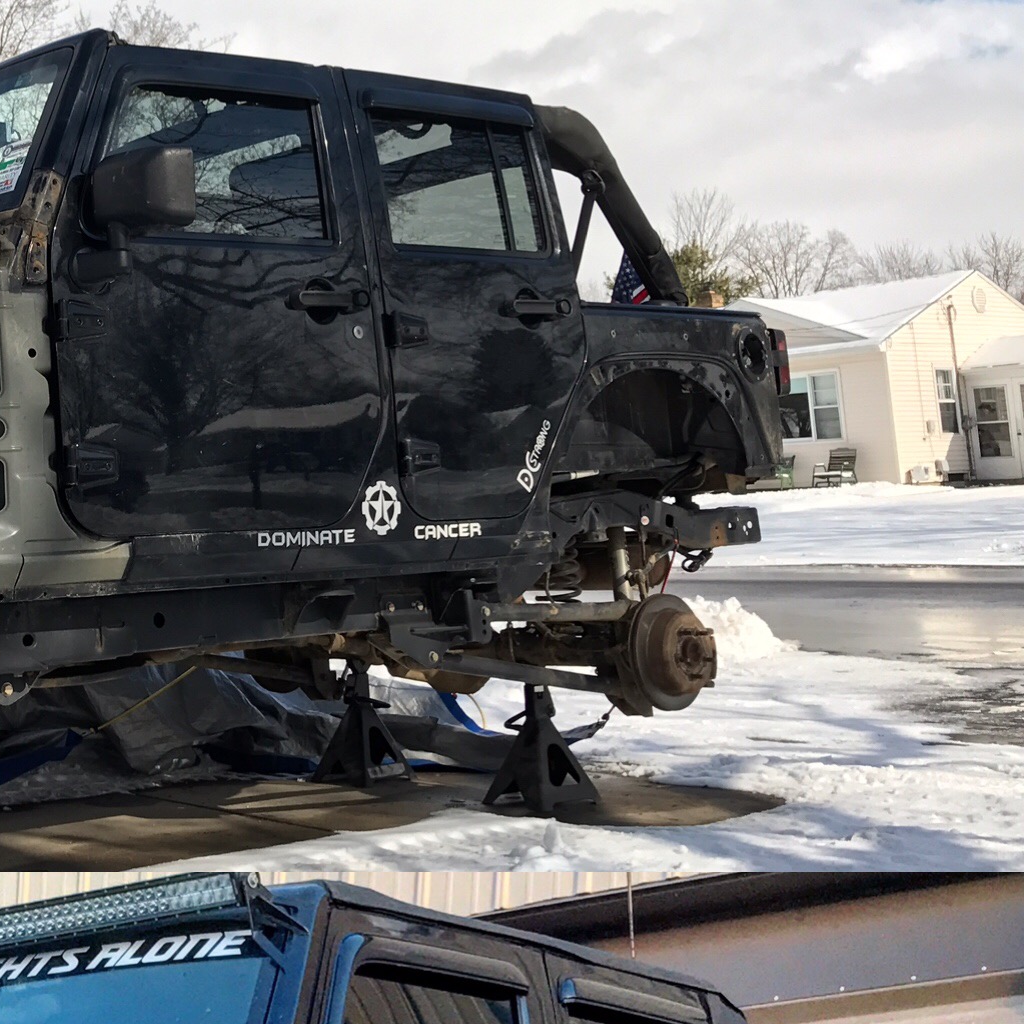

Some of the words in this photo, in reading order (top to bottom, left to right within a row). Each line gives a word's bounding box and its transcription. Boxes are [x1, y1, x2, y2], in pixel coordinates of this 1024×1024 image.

[529, 419, 551, 467] STRONG
[257, 528, 356, 547] DOMINATE
[414, 522, 482, 540] CANCER
[85, 929, 253, 971] ALONE
